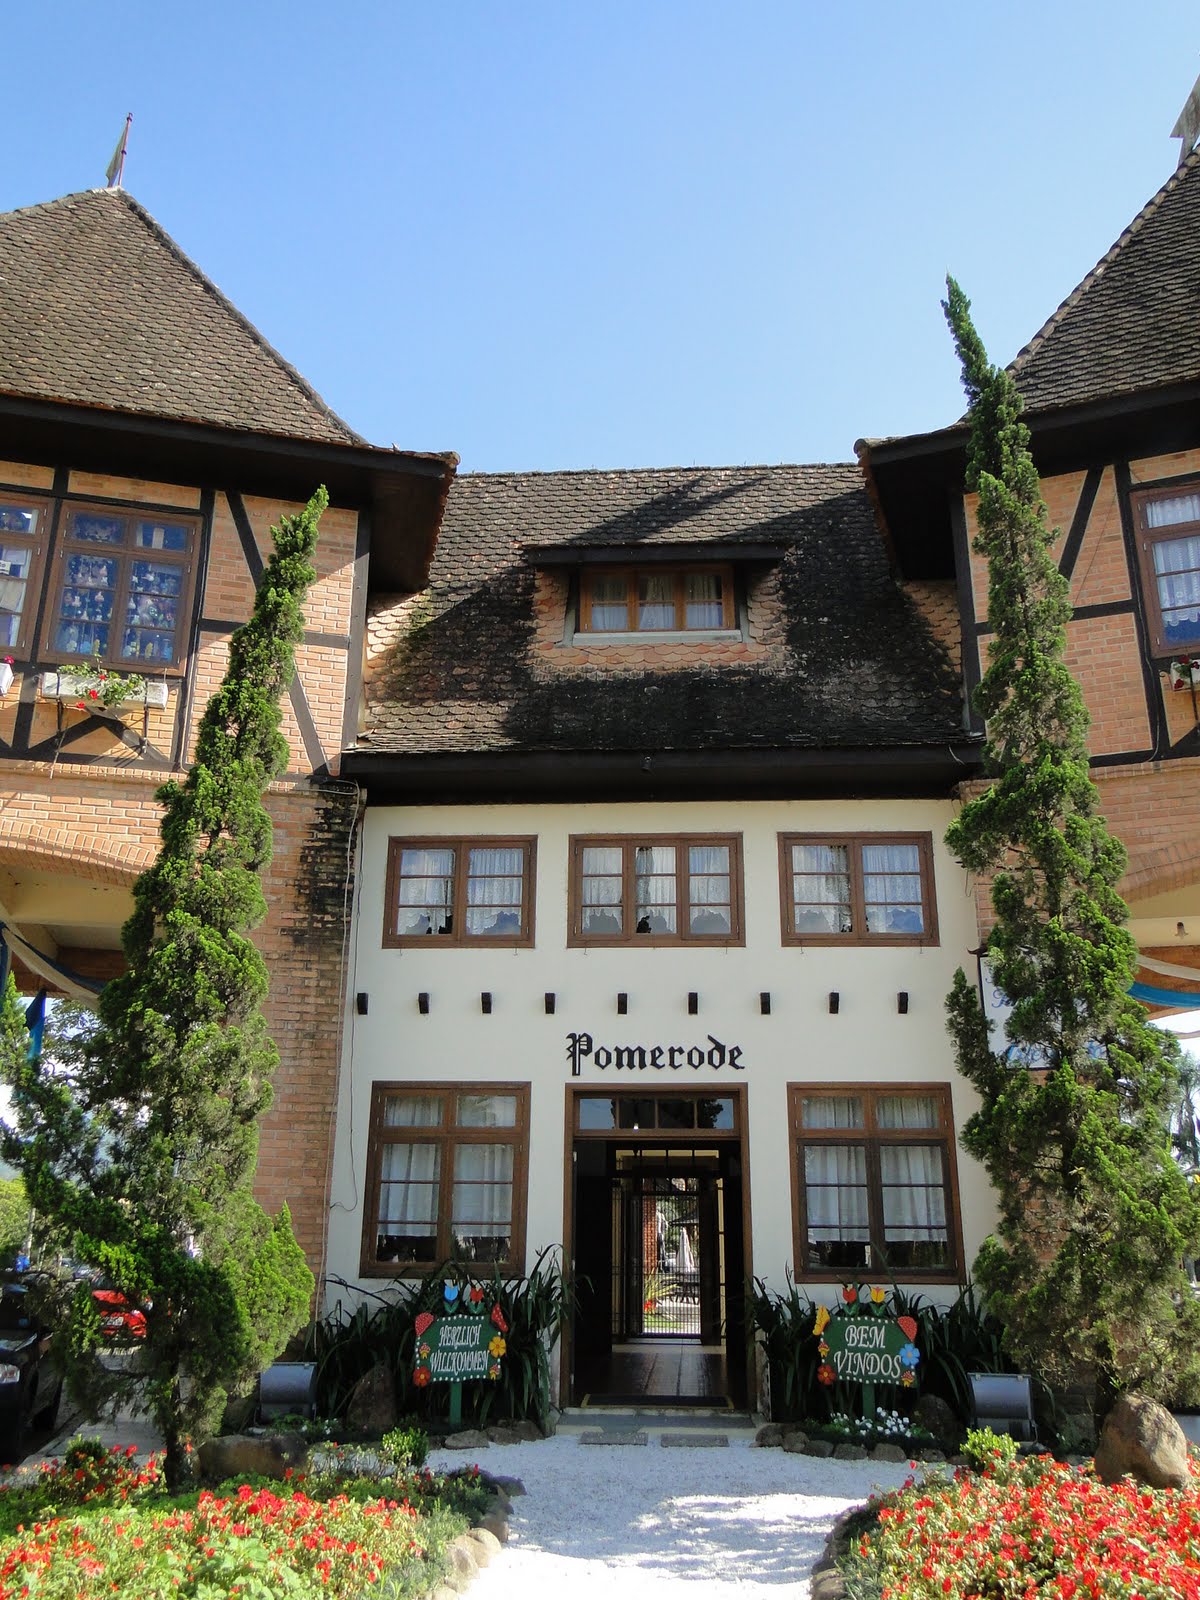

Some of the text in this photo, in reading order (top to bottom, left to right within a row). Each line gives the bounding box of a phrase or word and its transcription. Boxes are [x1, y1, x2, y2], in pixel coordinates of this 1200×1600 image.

[565, 1032, 745, 1076] Pomerode
[439, 1324, 482, 1349] HERZLICH
[845, 1324, 886, 1349] BEM
[430, 1349, 490, 1376] WILLKOMMEN
[833, 1348, 902, 1379] VINDOS
